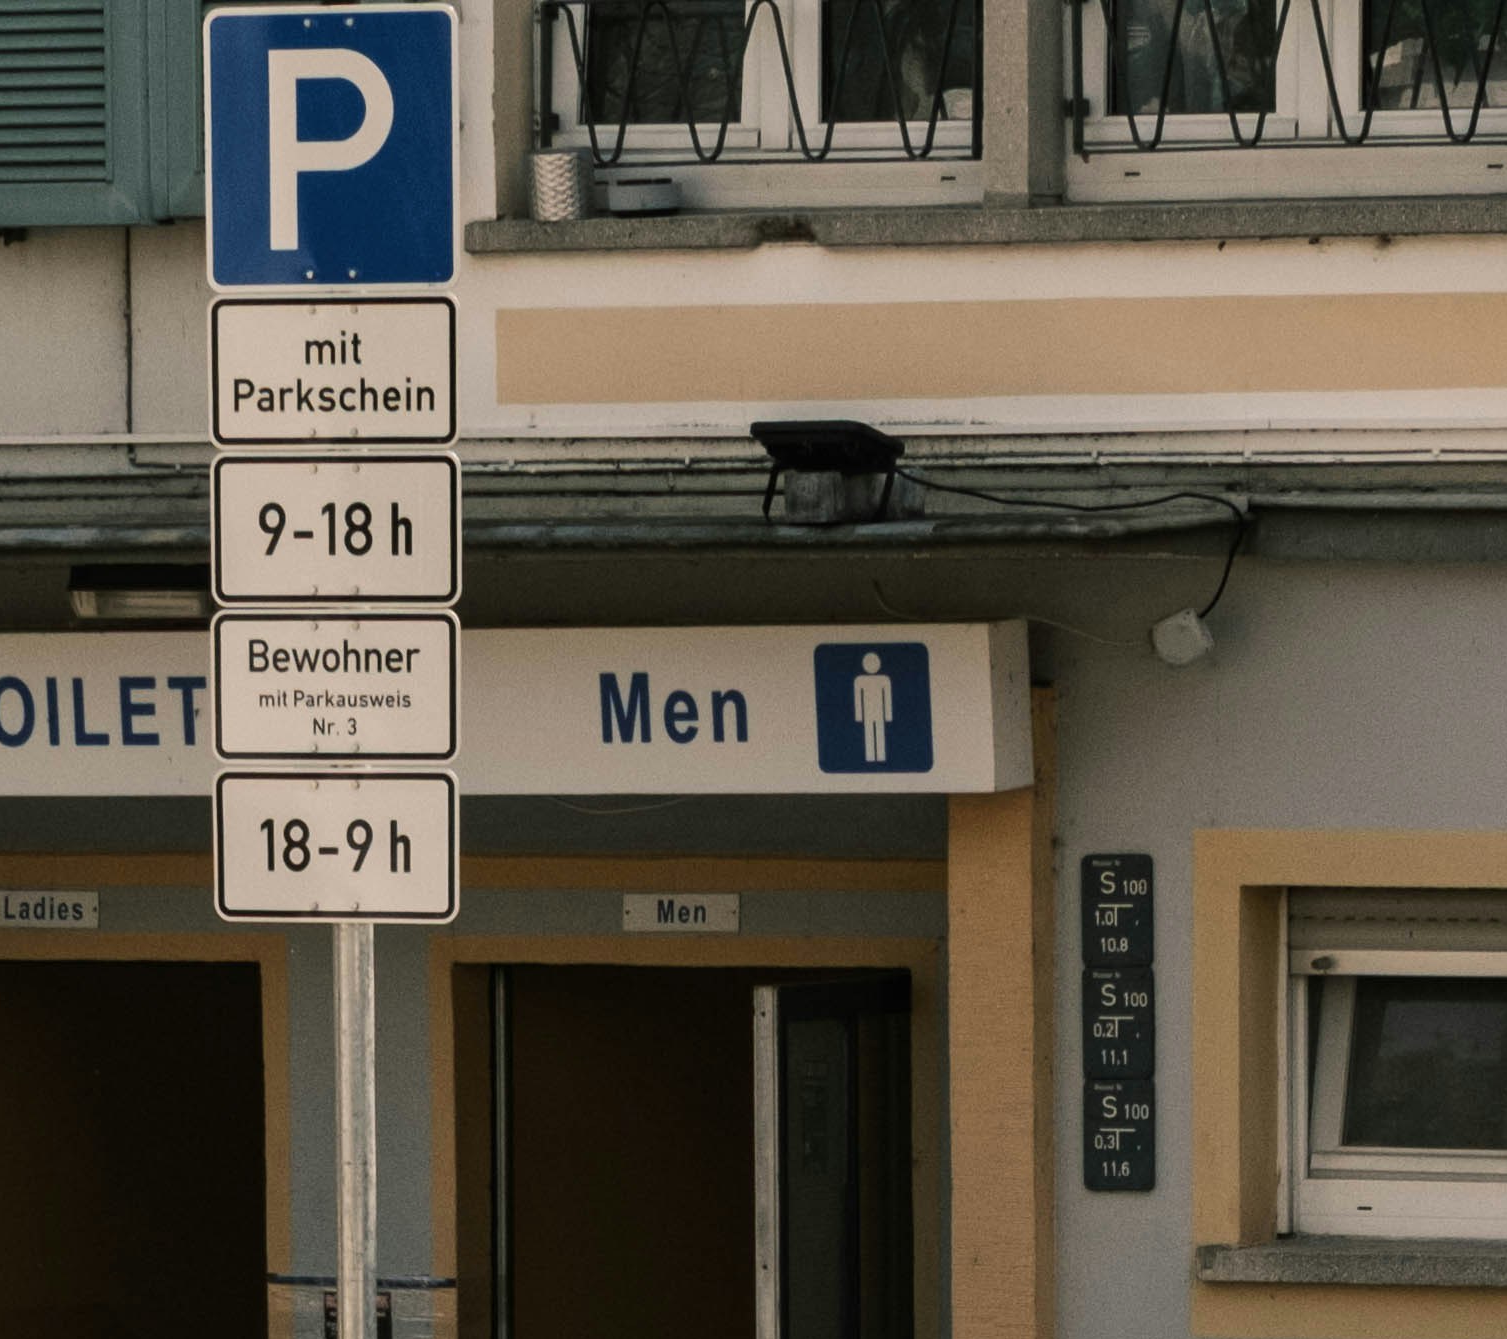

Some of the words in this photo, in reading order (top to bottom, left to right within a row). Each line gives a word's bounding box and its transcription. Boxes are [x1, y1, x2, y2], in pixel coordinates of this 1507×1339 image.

[268, 49, 394, 251] P
[305, 332, 362, 366] mit
[233, 379, 436, 413] Parkschein
[390, 503, 413, 556] h
[248, 639, 420, 675] Bewohner
[259, 691, 288, 708] mit
[293, 691, 412, 709] Parkausweis
[599, 671, 750, 744] Men
[313, 718, 340, 736] Nr.
[348, 718, 358, 736] 3
[390, 820, 411, 873] h
[1100, 872, 1116, 894] S
[1123, 879, 1147, 896] 100
[2, 895, 85, 922] Ladies
[656, 900, 708, 925] Men
[1100, 938, 1129, 953] 10.8
[1100, 984, 1117, 1007] S
[1123, 992, 1148, 1008] 100
[1102, 1095, 1118, 1119] S
[1124, 1104, 1149, 1120] 100
